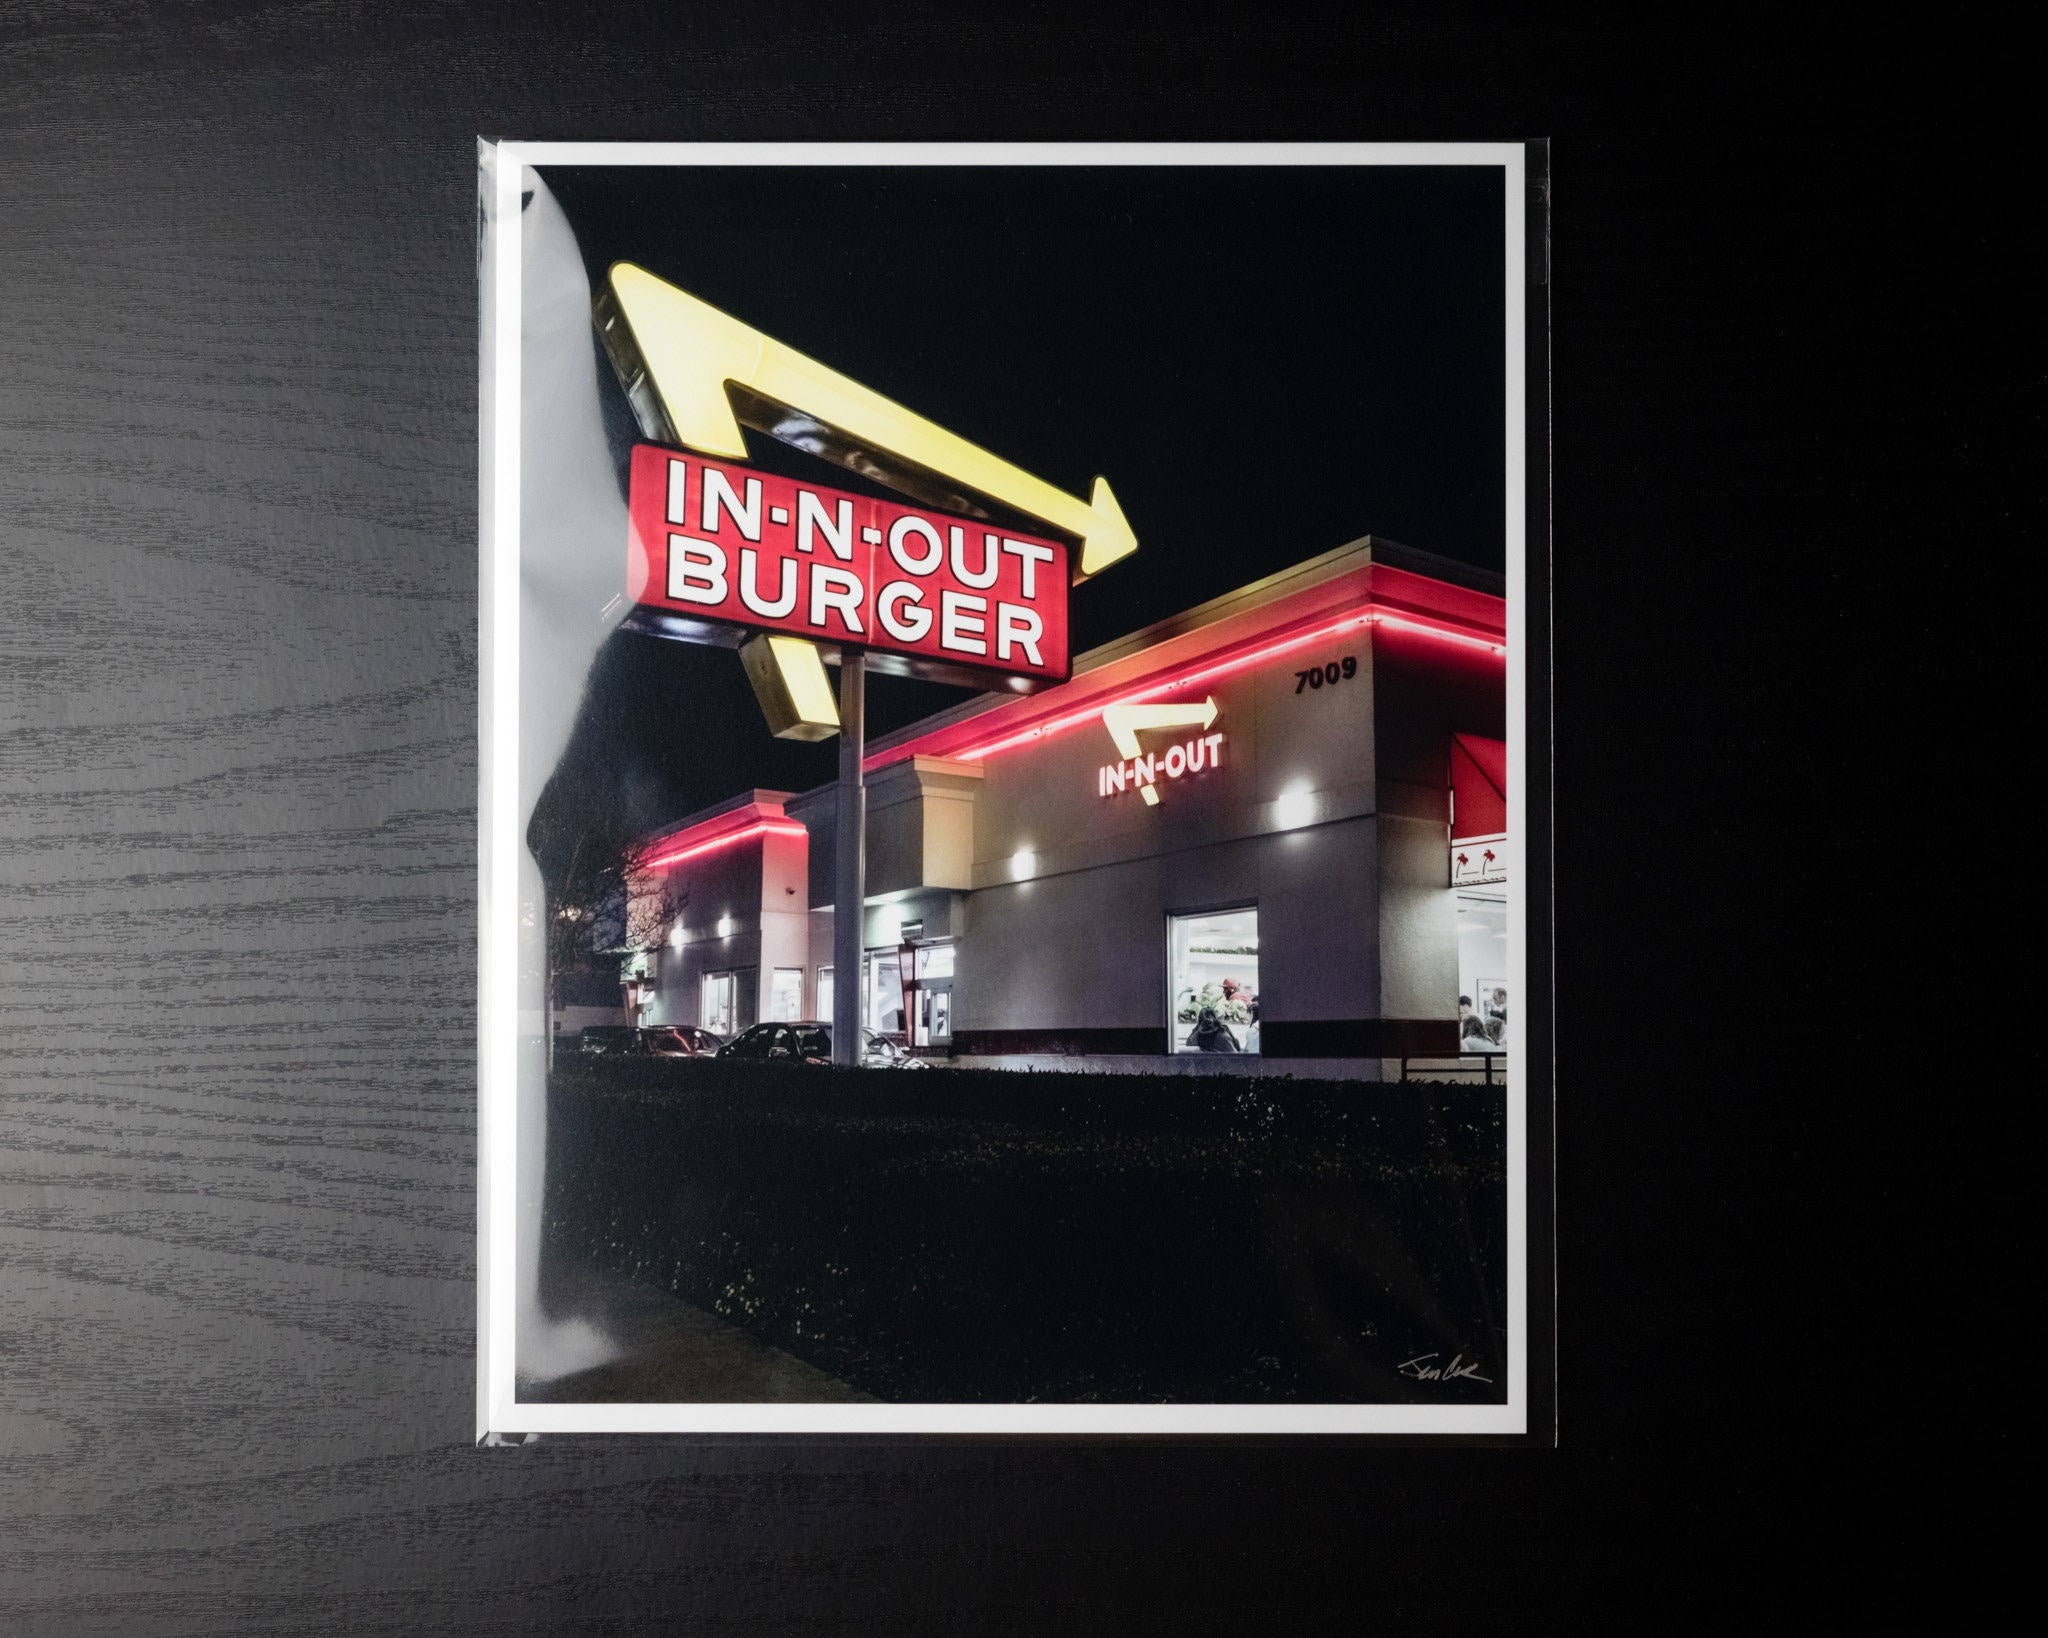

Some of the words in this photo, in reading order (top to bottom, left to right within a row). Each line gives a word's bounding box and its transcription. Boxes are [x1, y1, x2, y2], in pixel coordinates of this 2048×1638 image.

[667, 459, 1054, 599] IN-N-OUT
[668, 533, 1044, 666] BURGER
[1295, 656, 1357, 694] 7009
[1099, 733, 1223, 796] IN-N-OUT
